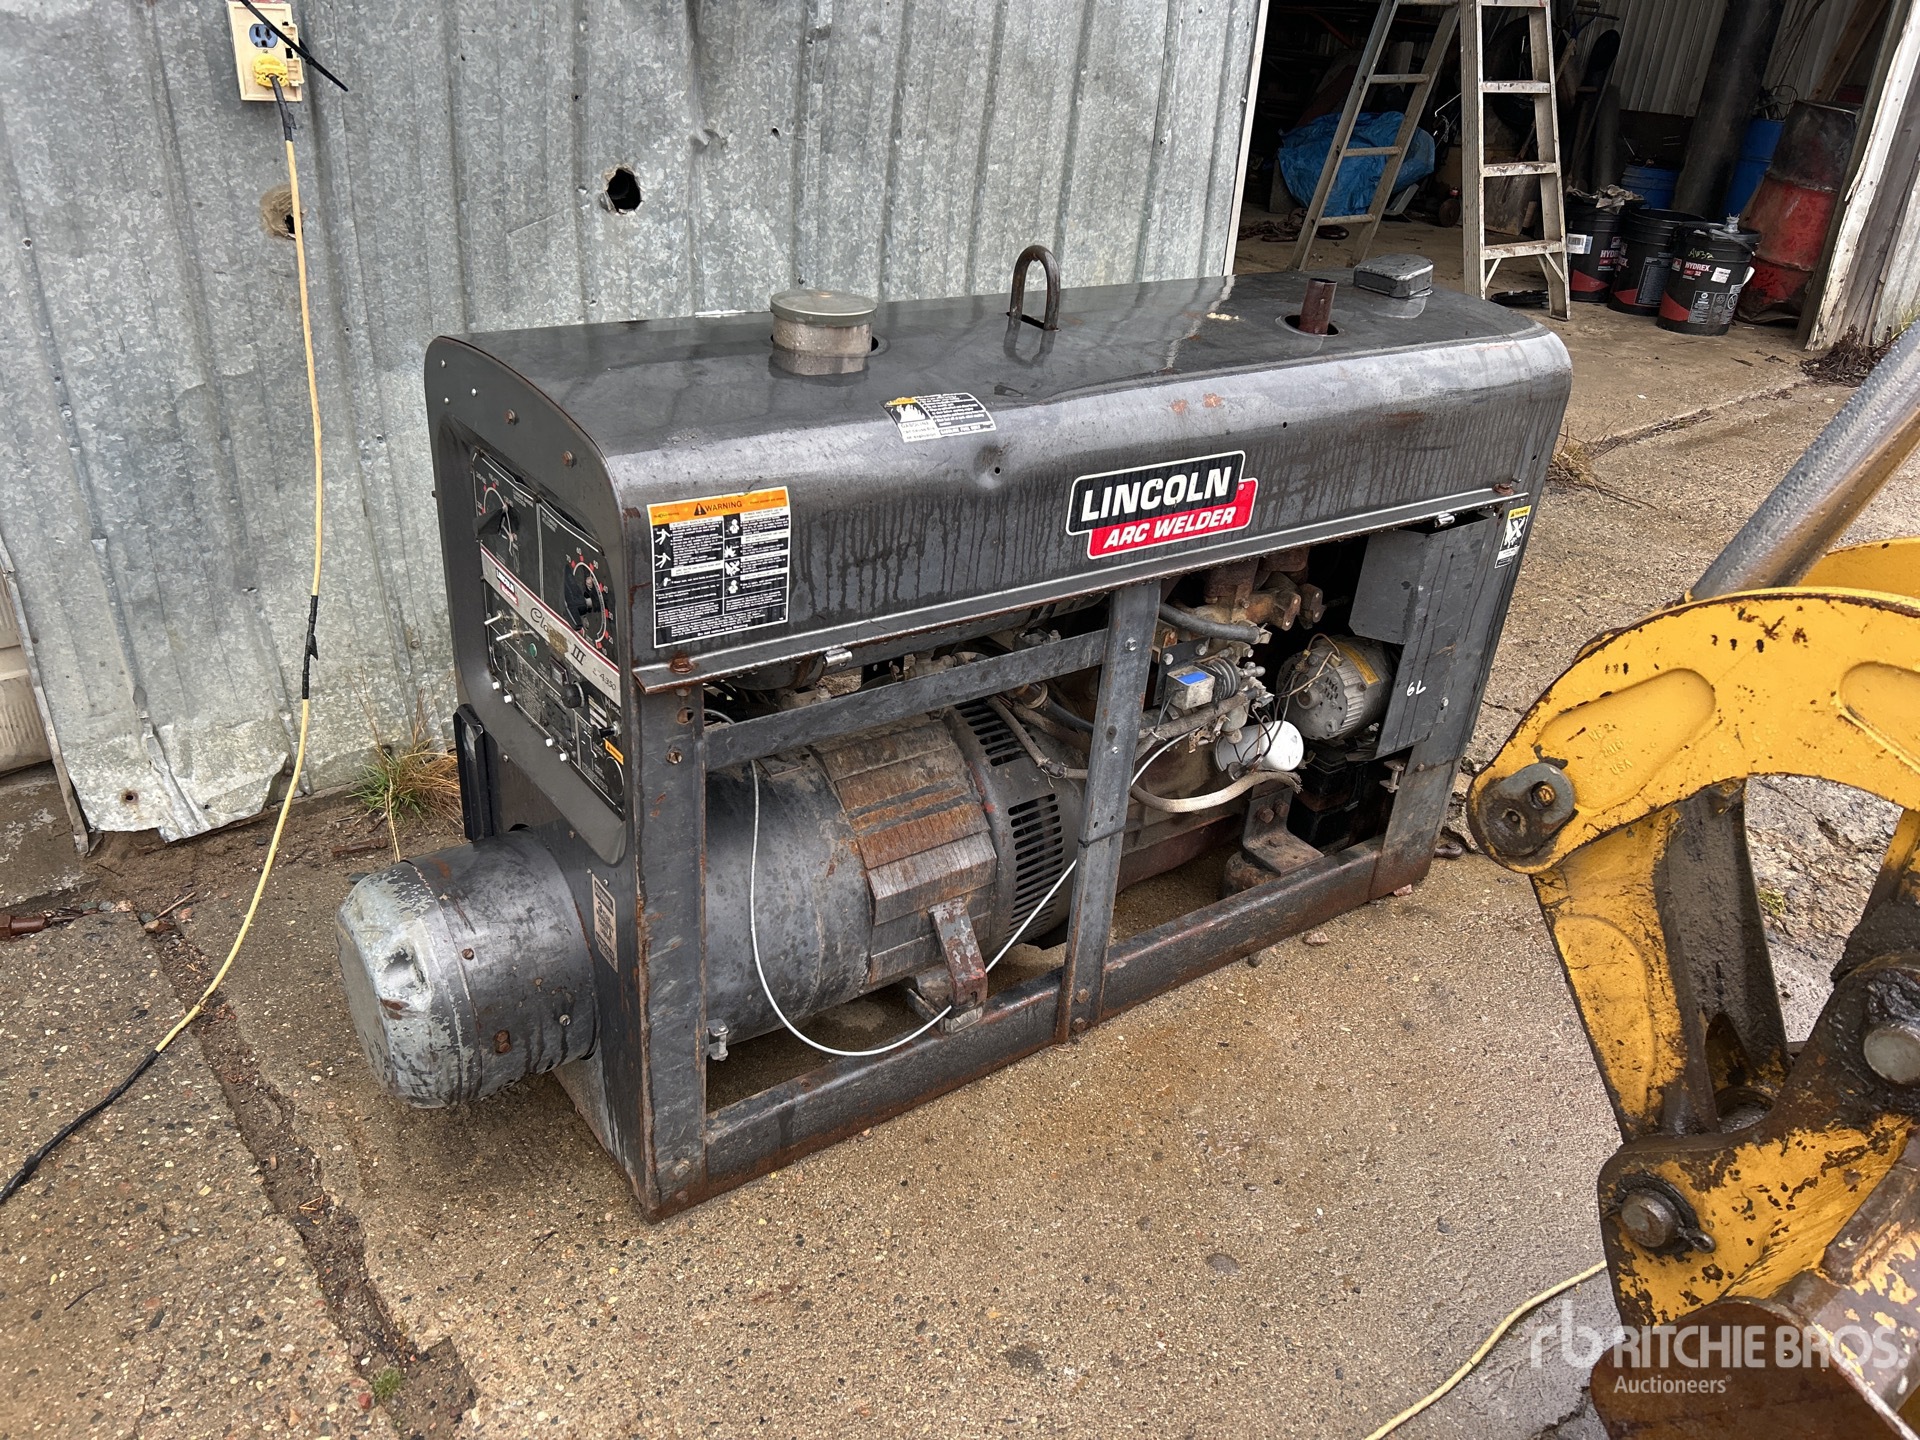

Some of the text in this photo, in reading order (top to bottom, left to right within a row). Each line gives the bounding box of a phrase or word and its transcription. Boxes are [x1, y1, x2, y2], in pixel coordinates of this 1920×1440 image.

[1684, 261, 1711, 272] HYDREX
[1081, 466, 1232, 522] LINCOLN
[705, 501, 742, 512] WARNING
[1103, 507, 1237, 549] ARC WELDER
[570, 643, 587, 666] III
